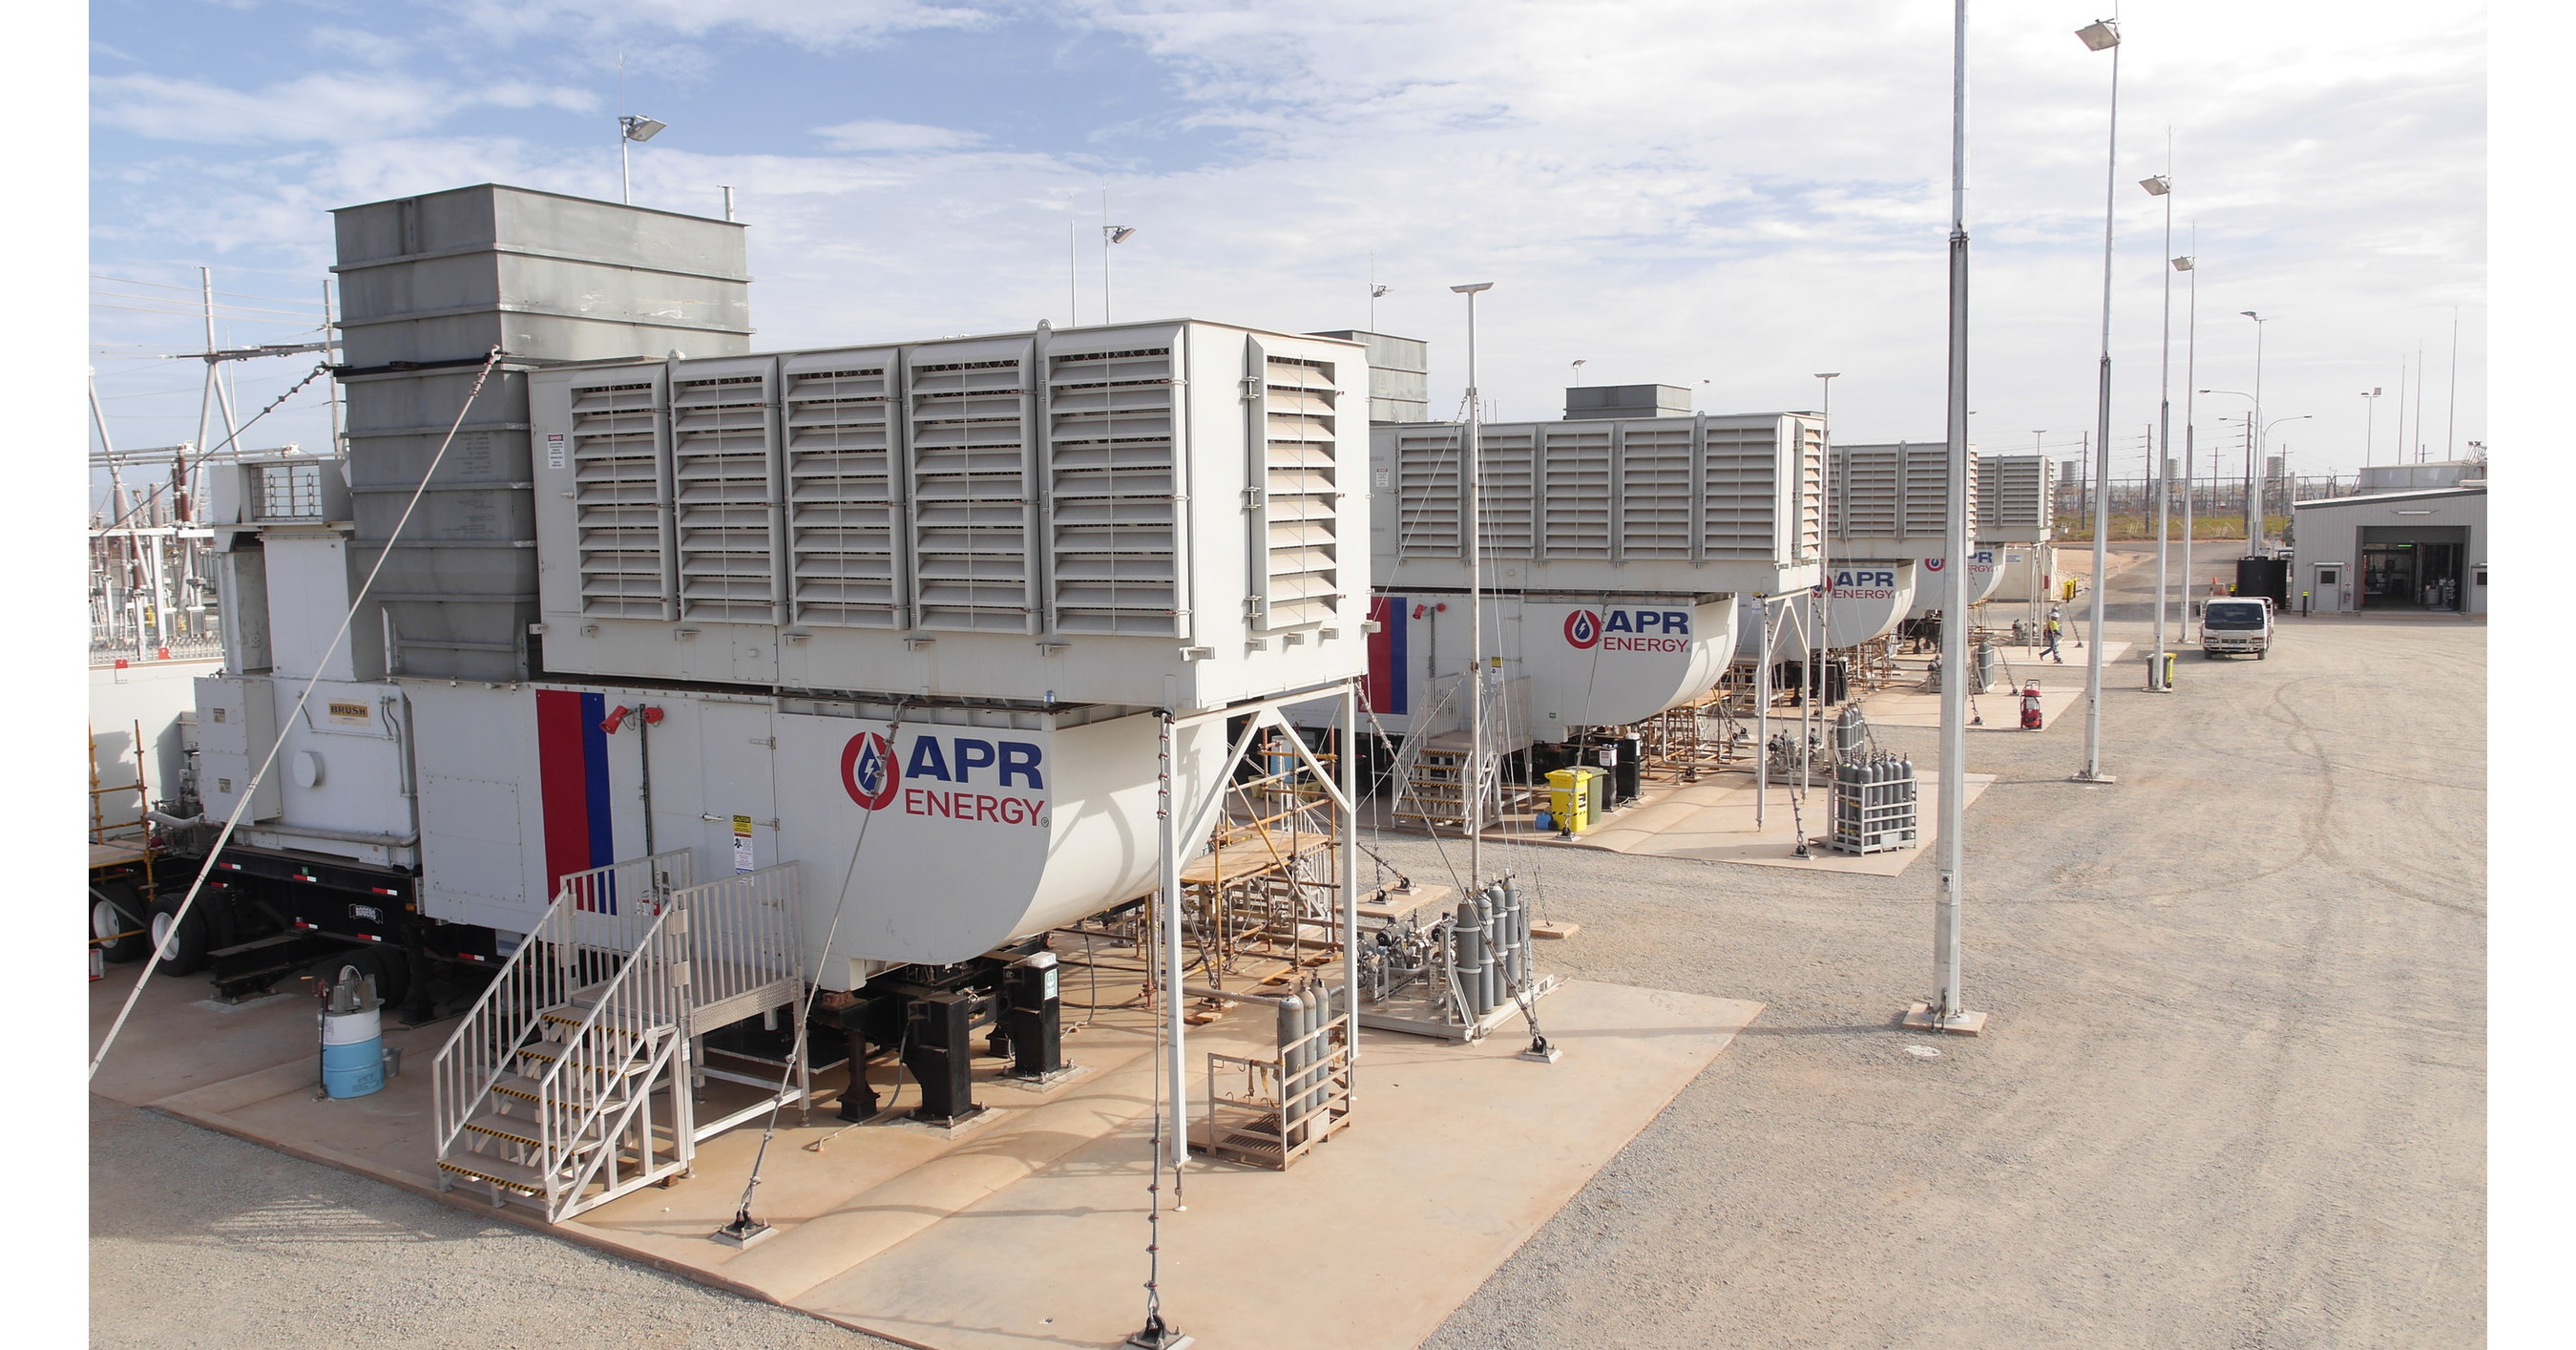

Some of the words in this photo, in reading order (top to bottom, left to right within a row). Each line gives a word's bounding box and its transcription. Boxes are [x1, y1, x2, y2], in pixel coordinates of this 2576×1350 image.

[1836, 571, 1894, 587] APR
[1833, 589, 1894, 600] ENERGY
[1604, 610, 1689, 635] APR
[1603, 637, 1689, 653] ENERGY
[330, 706, 366, 715] BRUSH
[905, 735, 1043, 790] APR
[905, 788, 1045, 827] ENERGY
